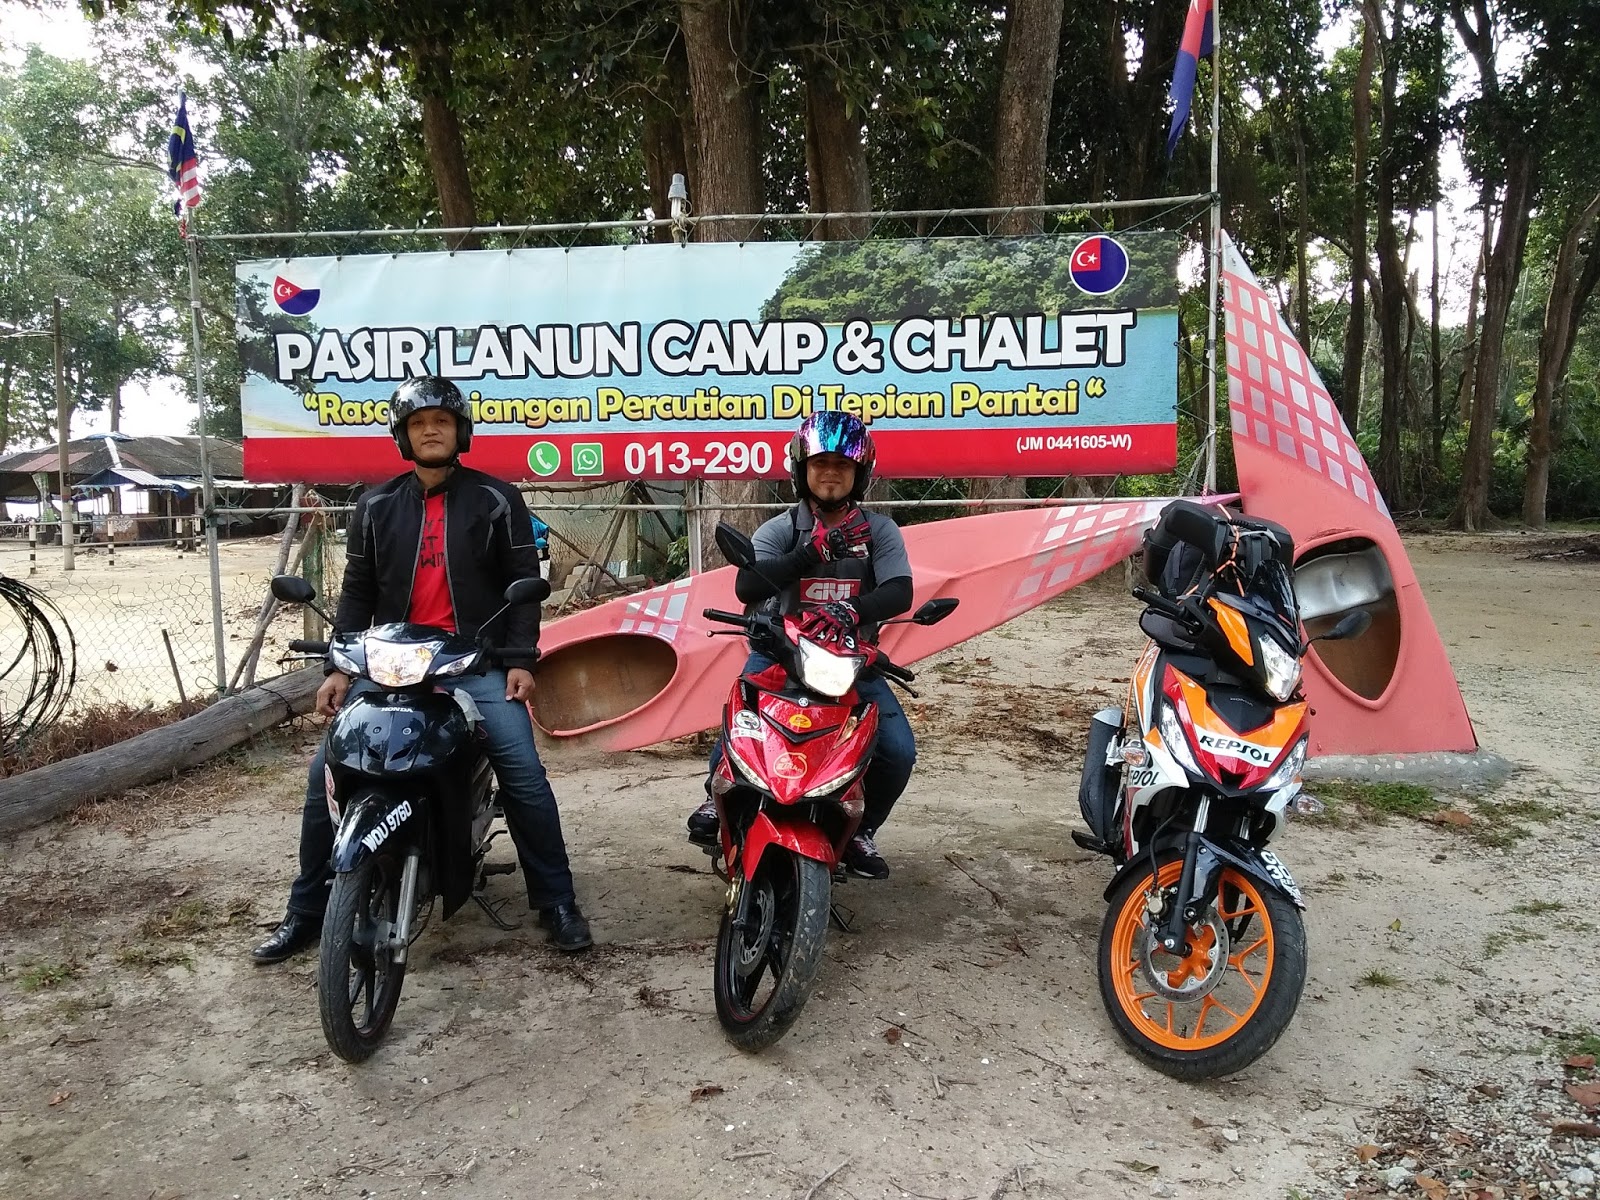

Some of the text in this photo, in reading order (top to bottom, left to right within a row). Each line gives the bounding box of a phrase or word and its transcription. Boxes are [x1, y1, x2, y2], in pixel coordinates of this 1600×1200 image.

[274, 308, 1136, 383] PASIR LANUN CAMP & CHALET
[469, 391, 591, 428] iangan
[597, 386, 766, 421] Percutian
[772, 384, 813, 420] Di
[818, 384, 946, 424] Tepian
[951, 379, 1079, 416] Pantai
[624, 441, 773, 475] 013-290
[1016, 433, 1132, 454] (JM 0441605-W)
[805, 583, 851, 600] GIVI
[1199, 735, 1272, 763] REPSOL
[1131, 769, 1160, 787] PSOL
[385, 800, 413, 832] 9760
